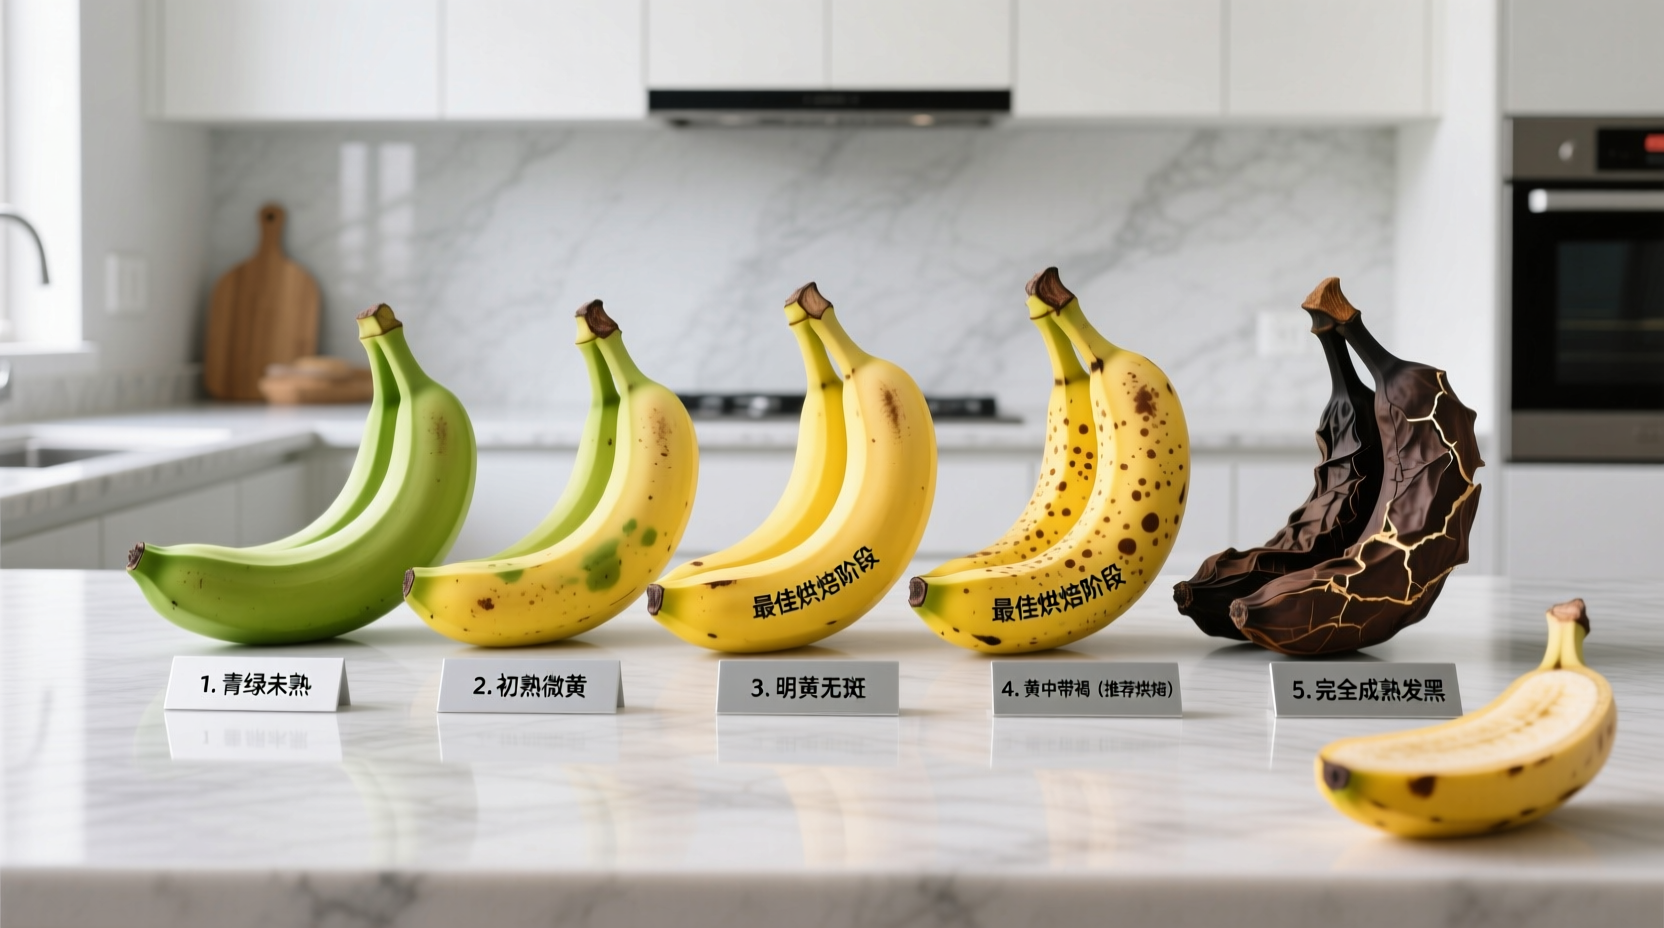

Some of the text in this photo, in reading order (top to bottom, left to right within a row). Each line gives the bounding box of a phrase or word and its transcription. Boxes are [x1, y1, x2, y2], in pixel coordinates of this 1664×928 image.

[752, 546, 880, 619] 最佳烘焙阶段
[992, 563, 1127, 623] 最佳烘焙阶段
[222, 672, 312, 697] 青绿未熟
[496, 673, 588, 698] 初熟微黄
[776, 676, 867, 699] 明黄无斑
[1316, 678, 1446, 702] 完全成熟发黑
